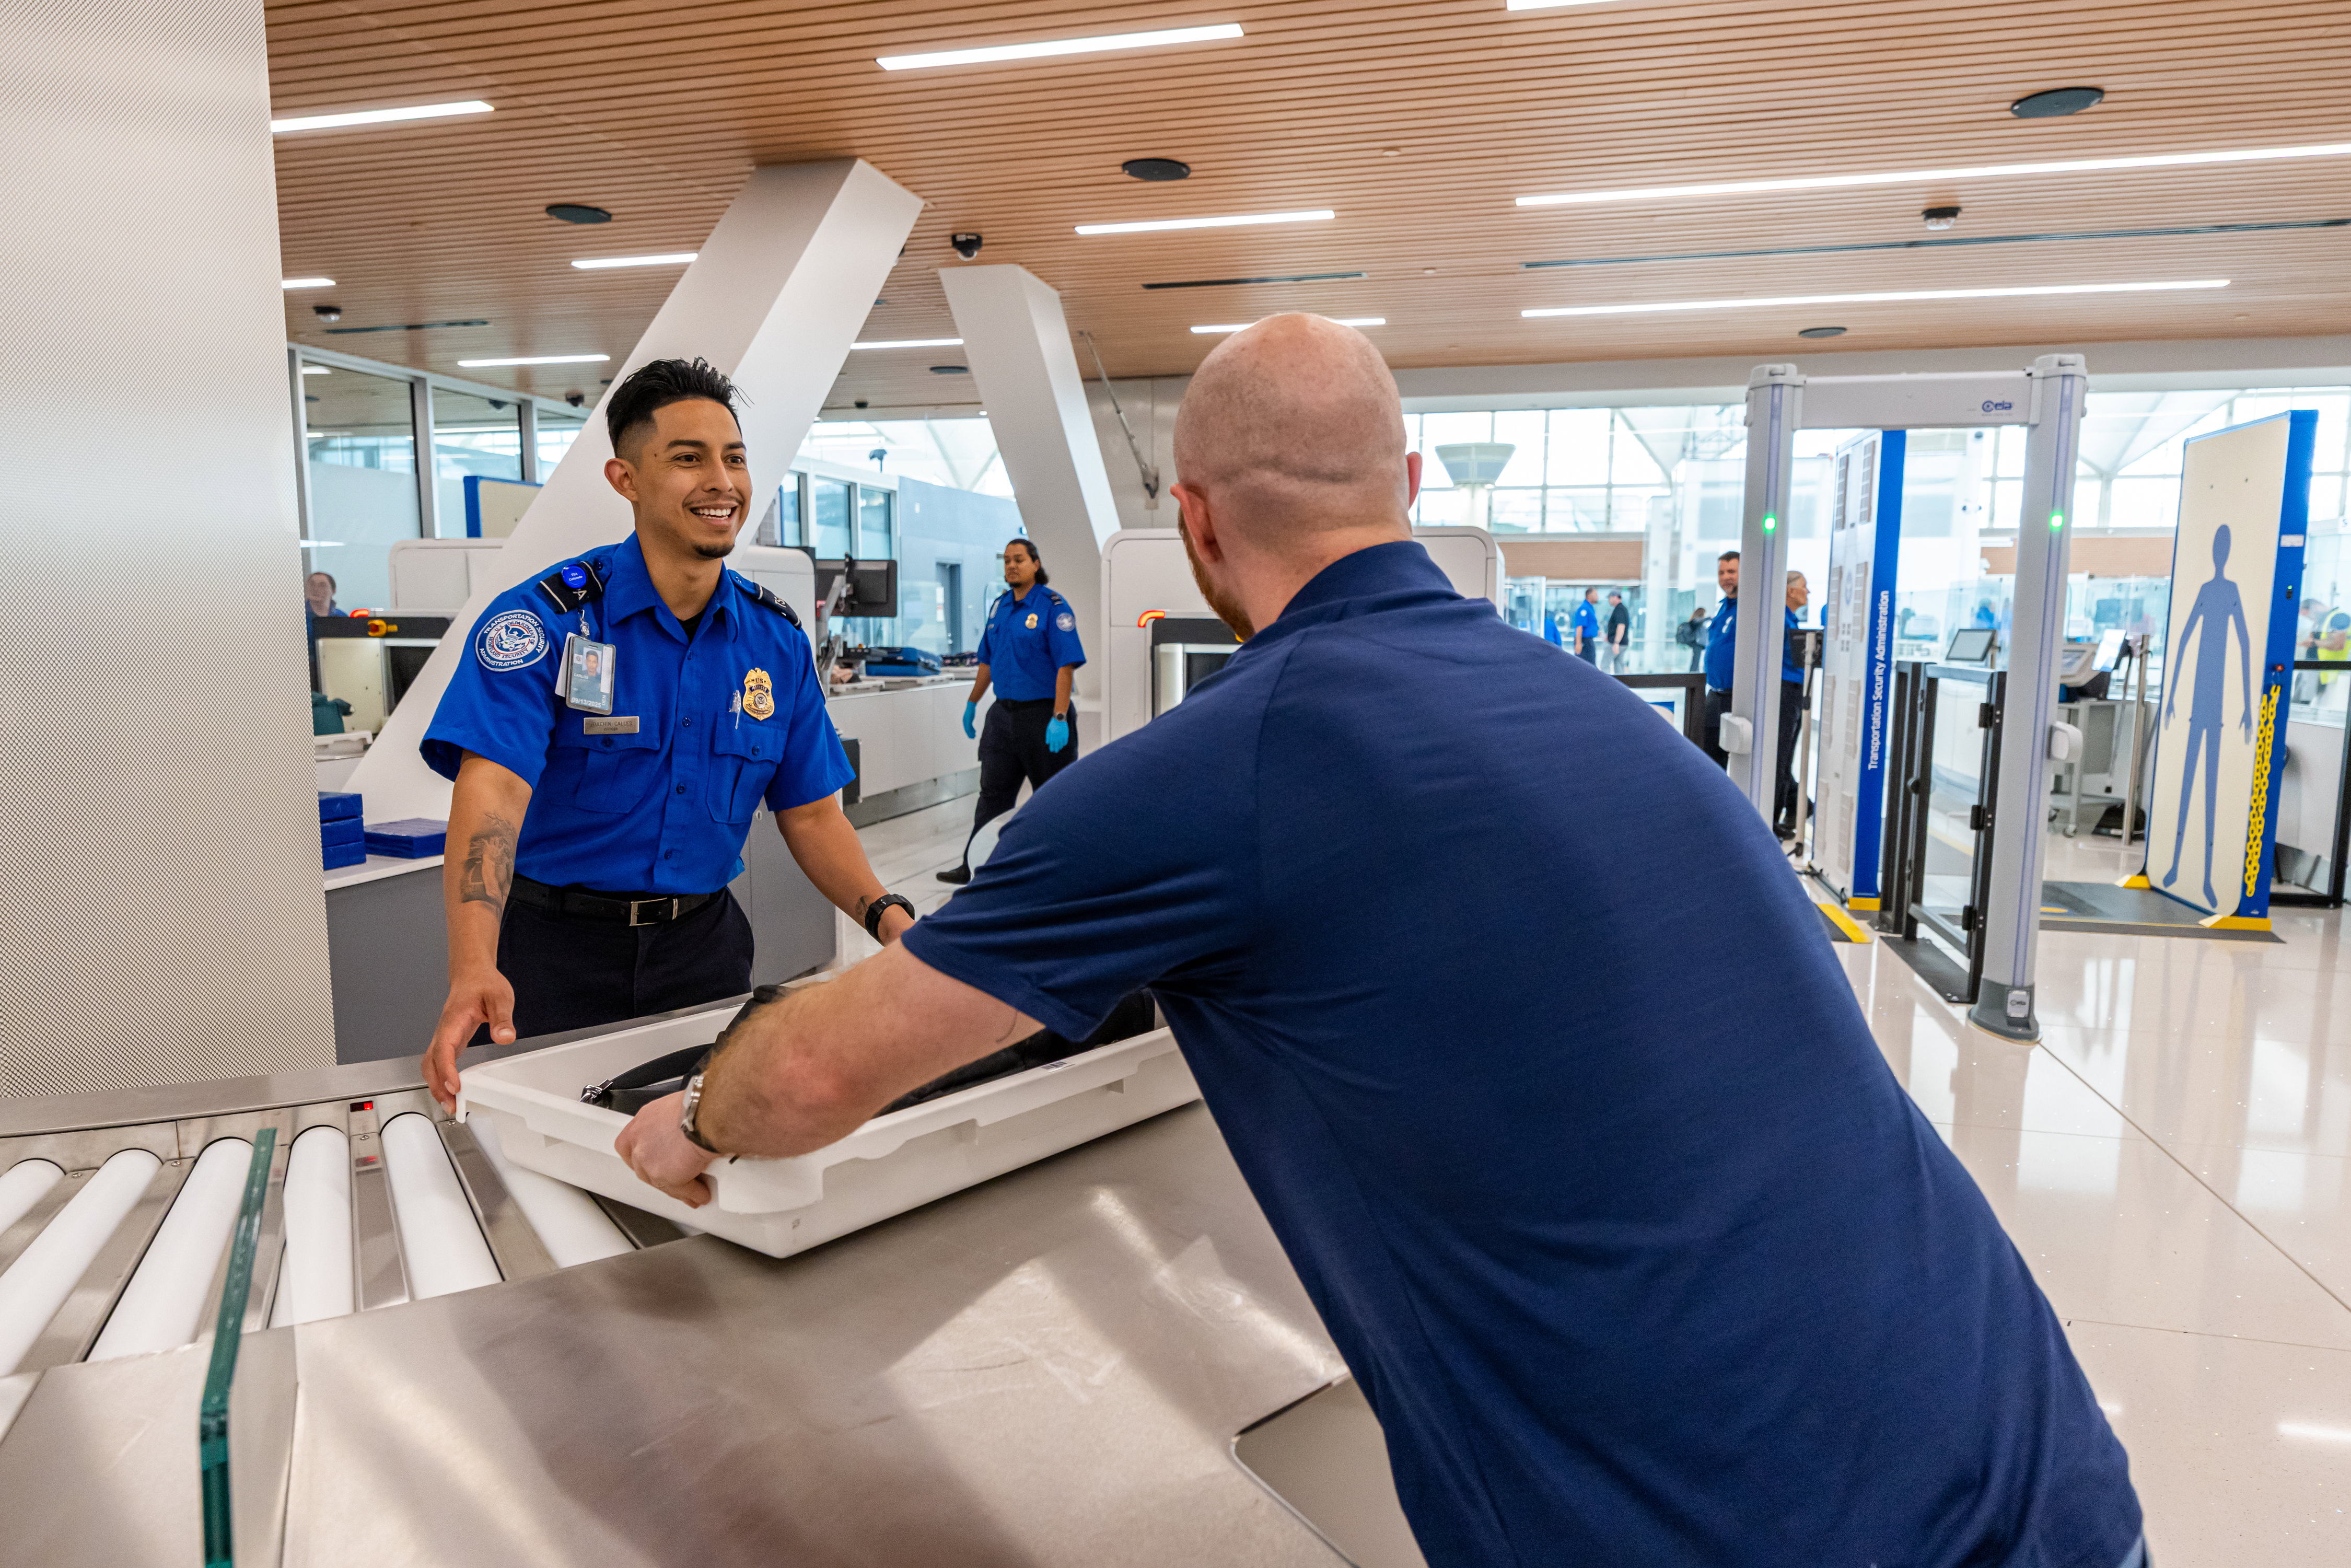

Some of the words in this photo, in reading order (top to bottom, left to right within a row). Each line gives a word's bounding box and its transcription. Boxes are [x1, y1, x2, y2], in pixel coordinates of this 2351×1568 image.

[774, 596, 786, 608] TS
[484, 613, 539, 634] TRANSPORTATION
[536, 627, 545, 653] SECURITY
[507, 621, 535, 638] DEPARTMENT
[1875, 590, 1889, 661] Administration
[480, 648, 523, 666] ADMINISTRATION
[488, 636, 501, 658] HOMELAND
[502, 648, 529, 658] SECURITY
[1872, 661, 1886, 701] Security
[572, 697, 601, 708] 09/13/2025
[1868, 702, 1882, 770] Transportation
